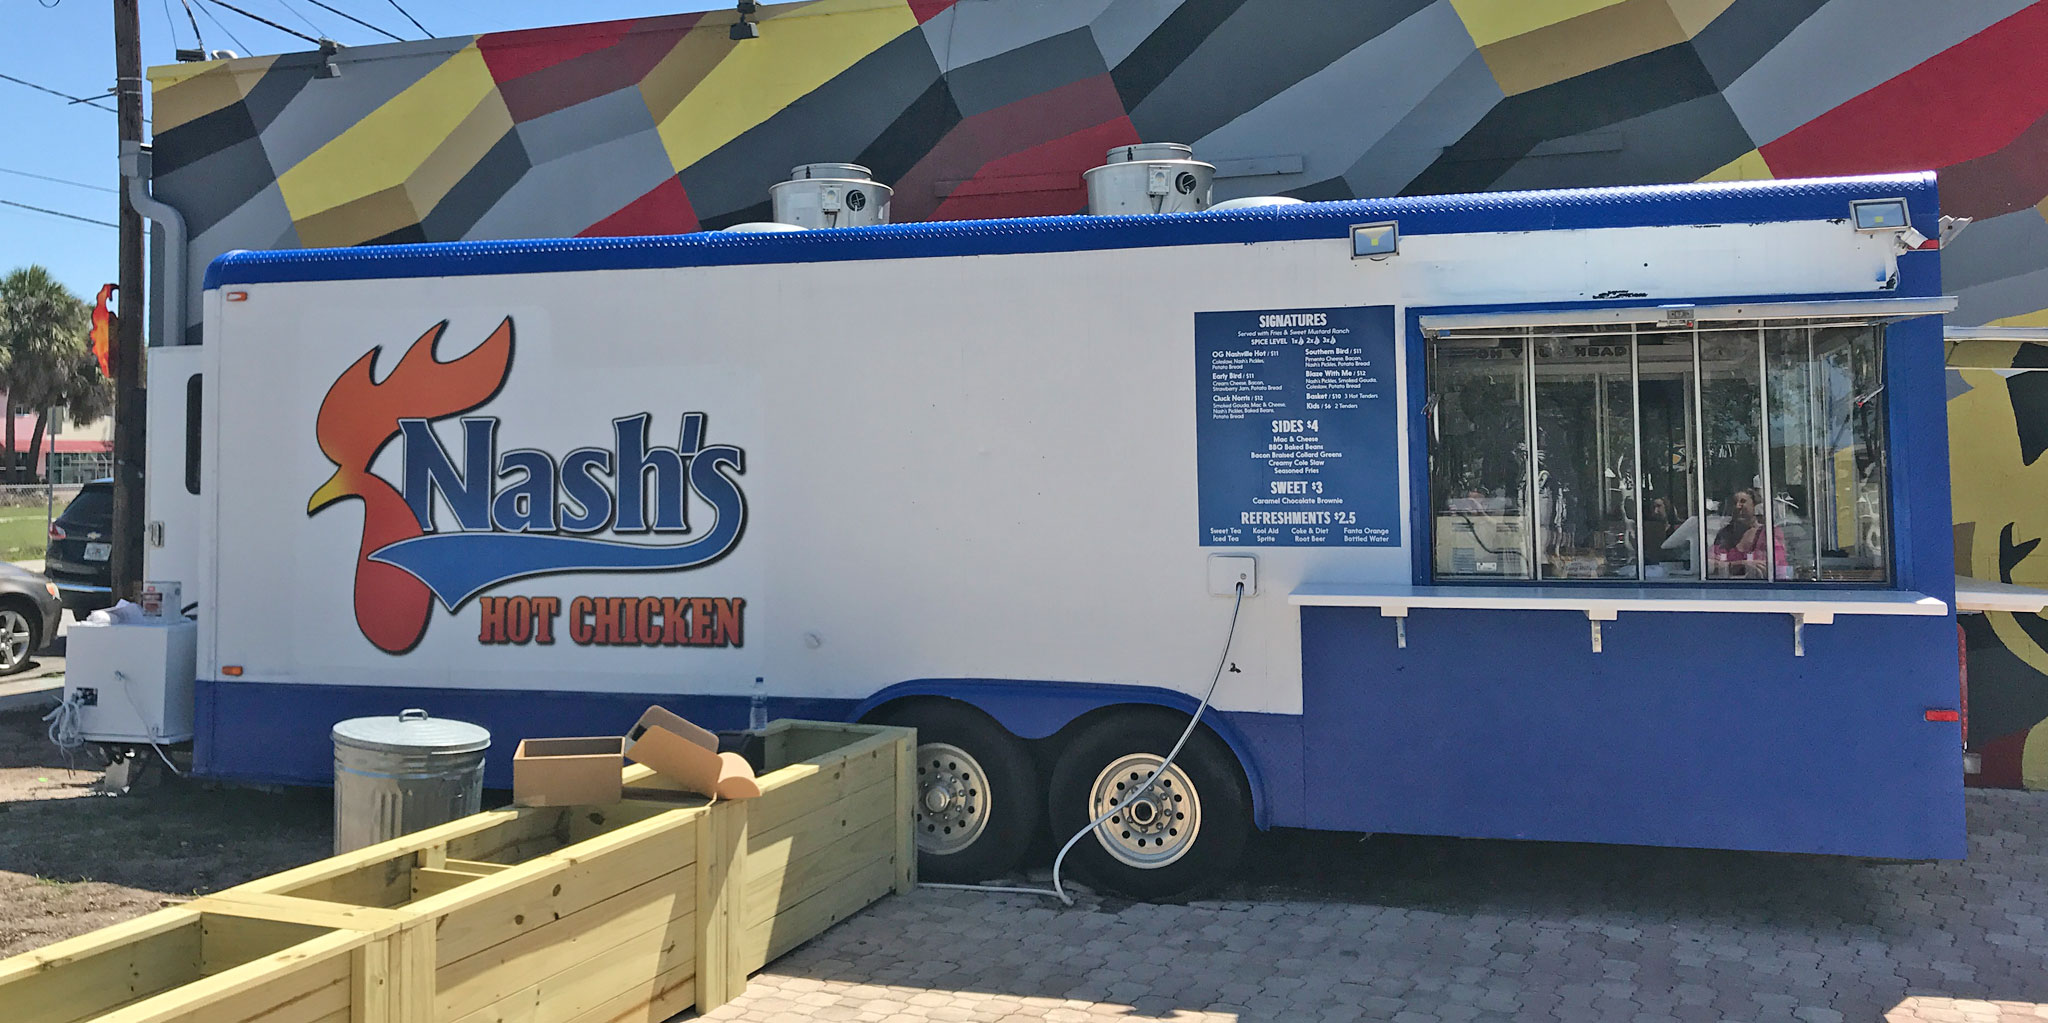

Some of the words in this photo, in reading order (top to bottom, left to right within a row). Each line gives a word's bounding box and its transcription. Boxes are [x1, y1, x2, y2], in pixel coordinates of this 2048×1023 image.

[1259, 313, 1327, 328] SIGNATURES
[1272, 420, 1304, 433] SIDES
[1307, 420, 1319, 432] $4
[396, 412, 748, 538] Nash's
[1270, 482, 1308, 494] SWEET
[1312, 482, 1323, 494] $3
[1241, 511, 1331, 524] REFRESHMENTS
[1334, 511, 1356, 524] $2.5
[478, 596, 560, 646] HOT
[569, 596, 746, 648] CHICKEN
